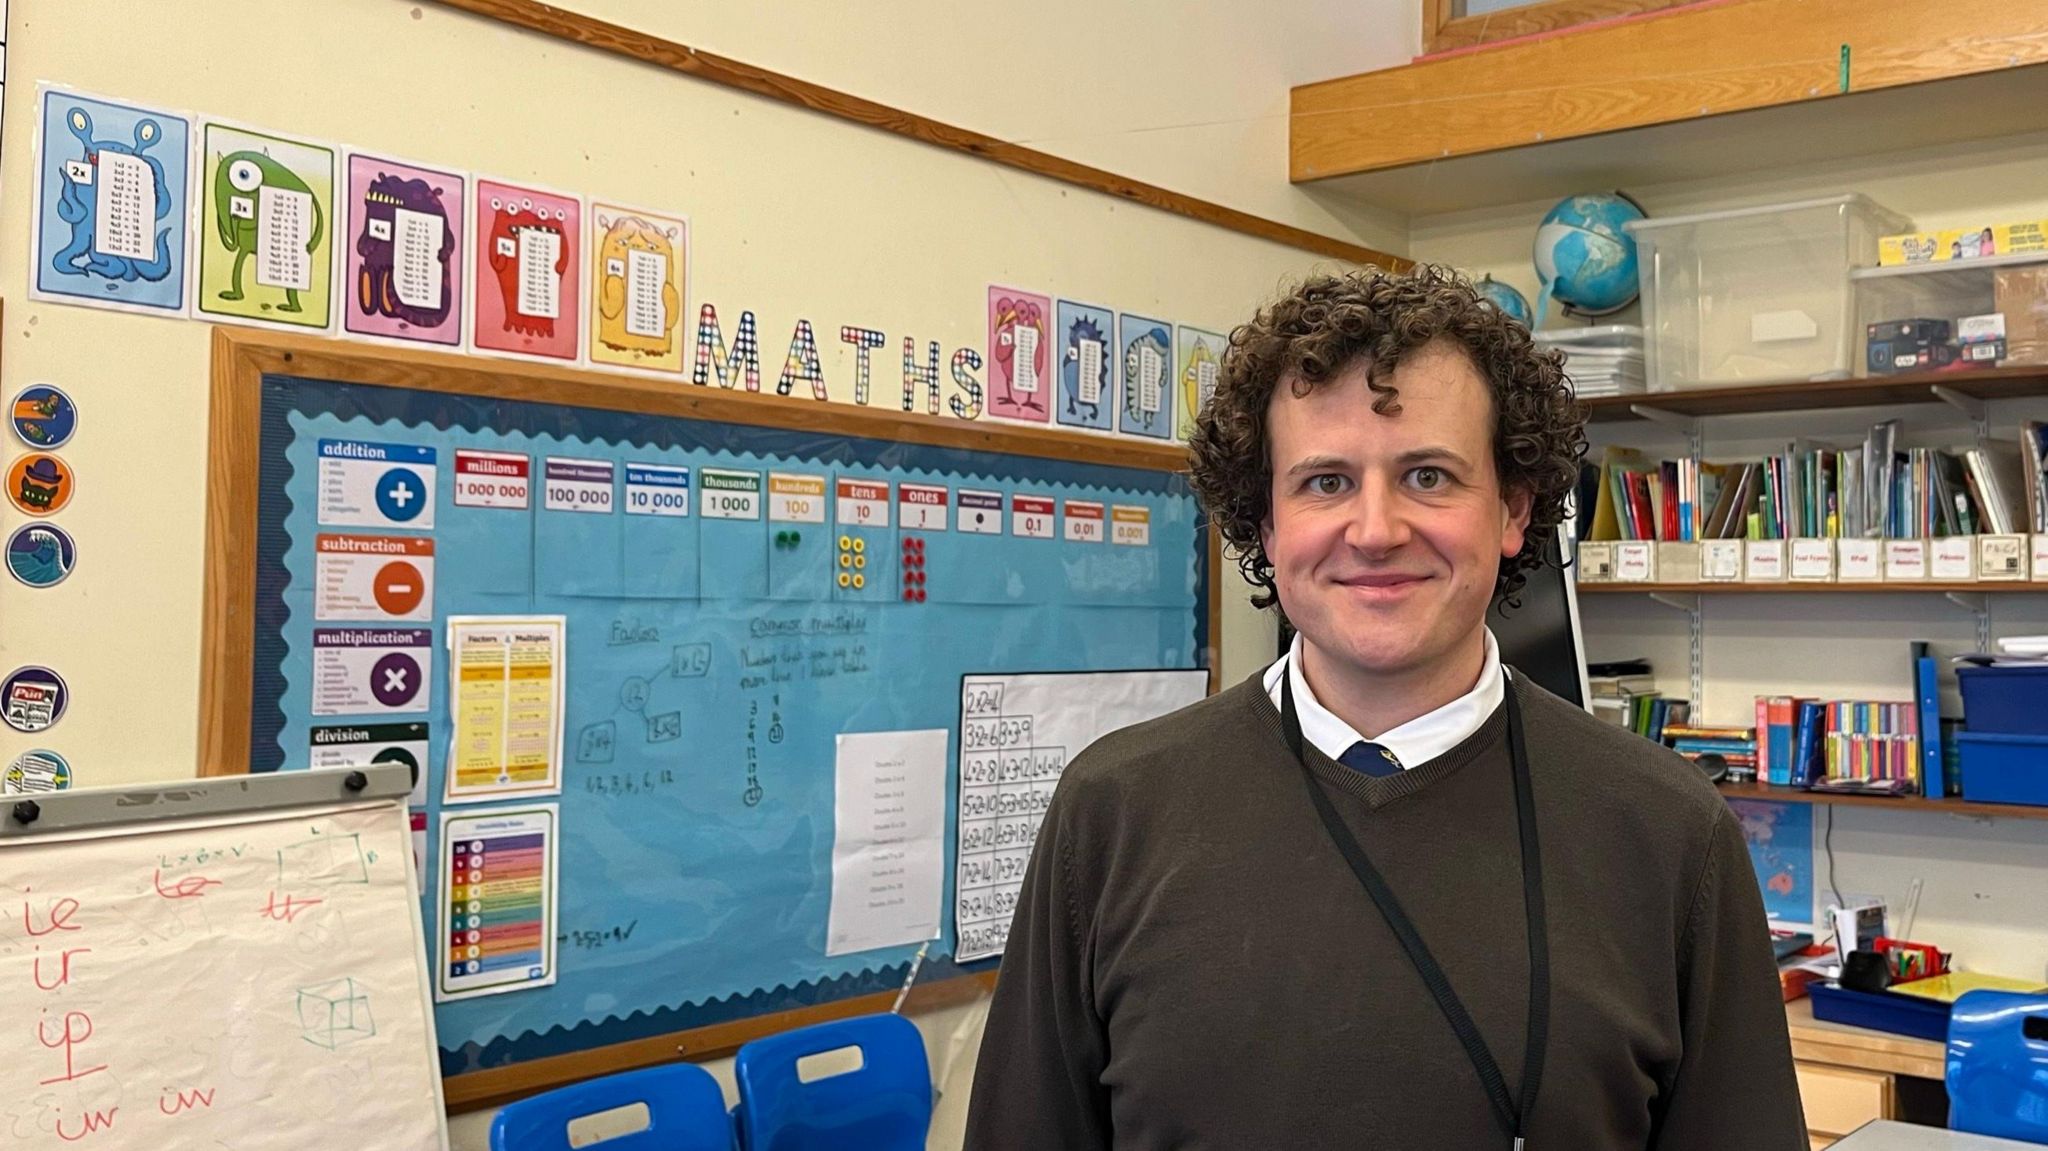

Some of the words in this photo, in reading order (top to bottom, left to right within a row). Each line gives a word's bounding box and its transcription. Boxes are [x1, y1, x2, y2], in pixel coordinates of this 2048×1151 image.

[72, 166, 86, 178] 2x
[692, 304, 982, 420] MATHS
[323, 441, 386, 459] addition
[467, 459, 518, 475] millions
[644, 474, 686, 485] thousands
[704, 478, 757, 490] thousands
[775, 480, 820, 493] hundreds
[458, 483, 463, 495] 1
[468, 483, 495, 496] 000
[499, 485, 526, 498] 000
[548, 488, 575, 502] 100
[580, 490, 609, 504] 000
[851, 486, 877, 499] tens
[908, 491, 939, 504] ones
[631, 492, 648, 505] 10
[653, 494, 684, 508] 000
[711, 496, 716, 509] 1
[721, 497, 750, 511] 000
[786, 500, 809, 514] 100
[856, 506, 870, 518] 10
[920, 509, 926, 523] 1
[1025, 517, 1042, 532] 0.1
[1073, 522, 1094, 535] 0.01
[1117, 526, 1143, 539] 0.001
[321, 537, 406, 553] subtraction
[318, 630, 414, 647] multiplication
[315, 728, 370, 743] division
